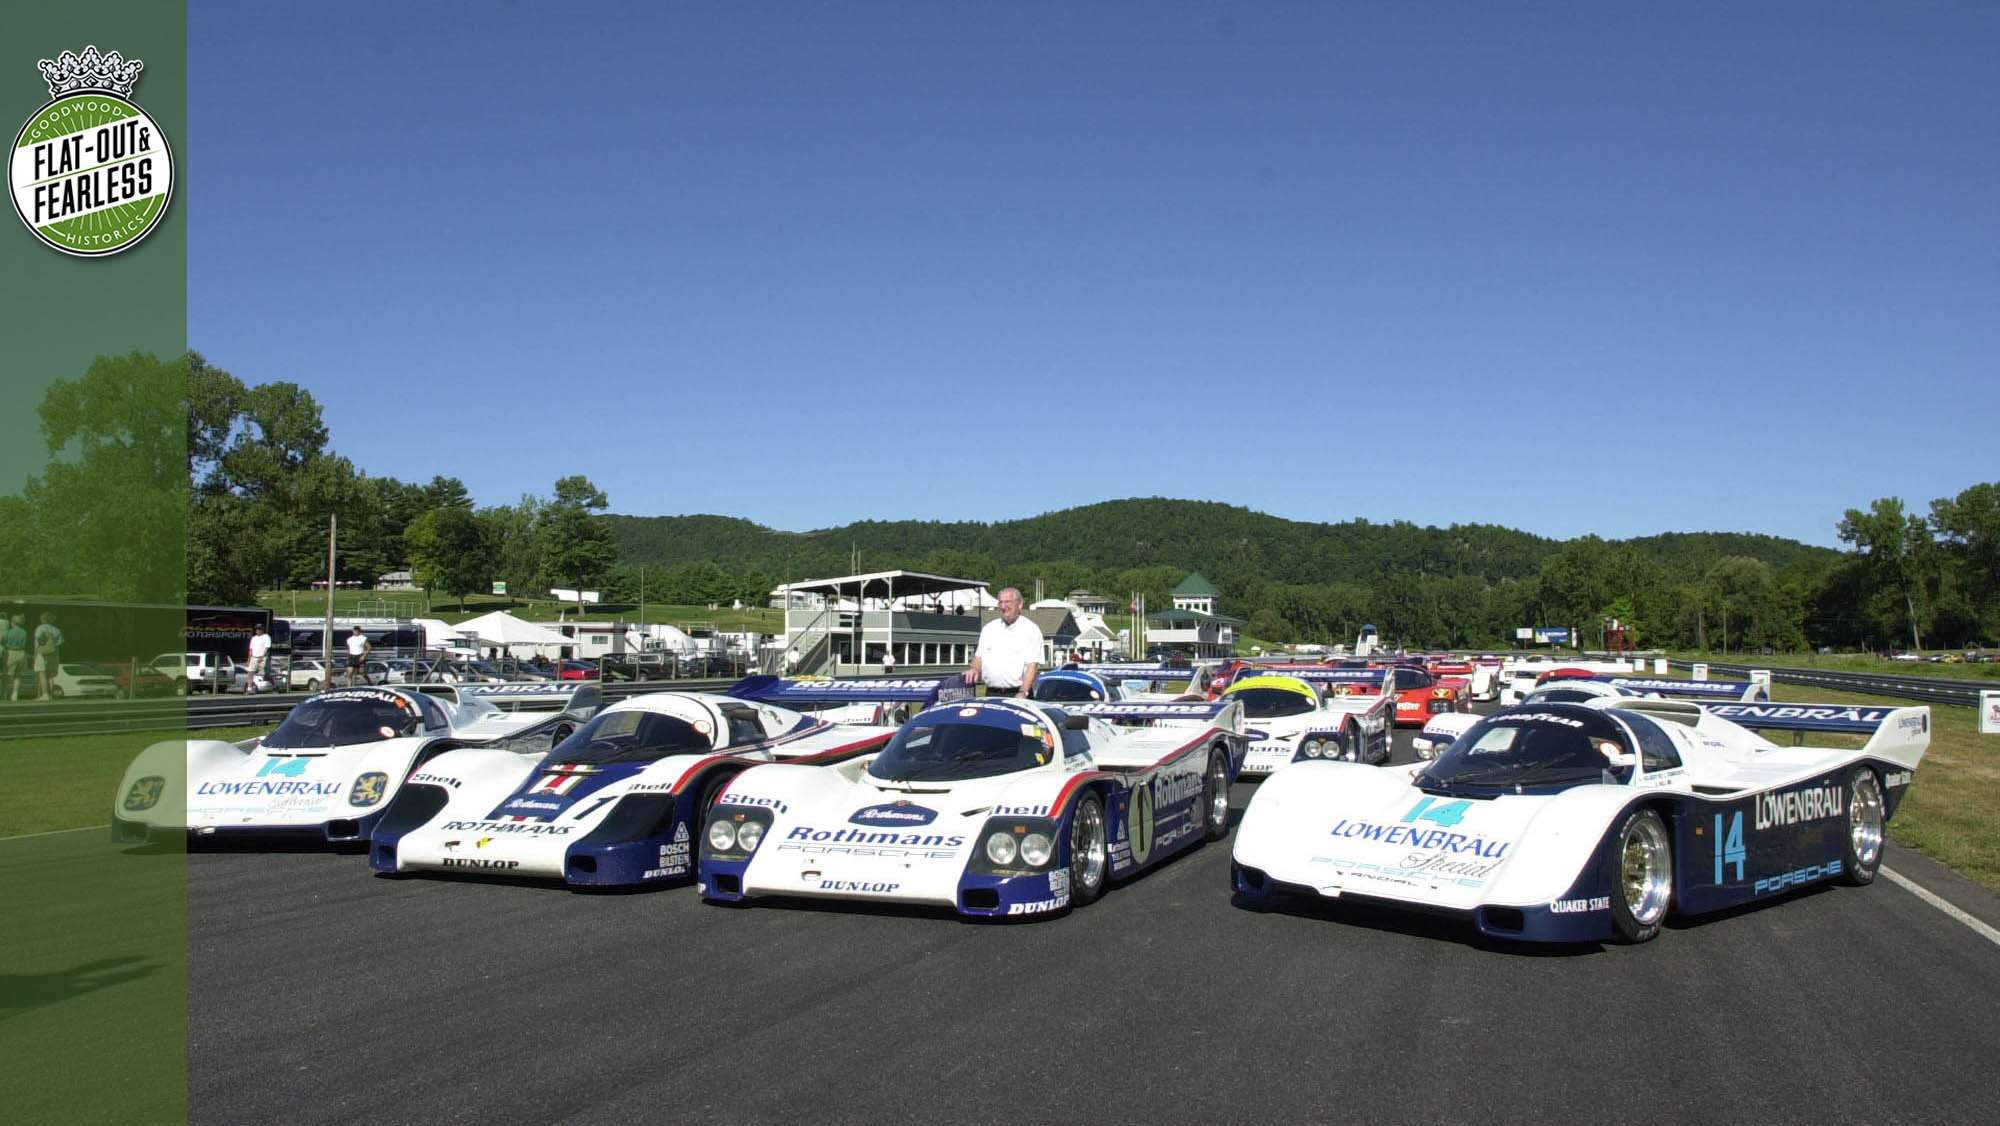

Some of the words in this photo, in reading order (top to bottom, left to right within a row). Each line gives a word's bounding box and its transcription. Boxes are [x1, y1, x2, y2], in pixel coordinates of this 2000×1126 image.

[793, 680, 940, 688] ROTHMANS
[1610, 679, 1737, 691] Rothmans
[255, 757, 312, 777] 14
[412, 773, 463, 788] Shell
[723, 793, 788, 814] Shell
[1755, 779, 1843, 831] LÖWENBRÄU
[1400, 796, 1476, 828] 14
[441, 821, 576, 835] ROTHMANS
[787, 826, 966, 847] Rothmans
[660, 842, 690, 856] BOSCH
[777, 844, 956, 858] PORSCHE
[1714, 811, 1746, 886] 14
[442, 857, 520, 870] DUNLOP
[1754, 859, 1842, 896] PORSCHE
[820, 880, 901, 893] DUNLOP
[1550, 898, 1588, 913] QUAKER
[1589, 896, 1610, 911] STATE
